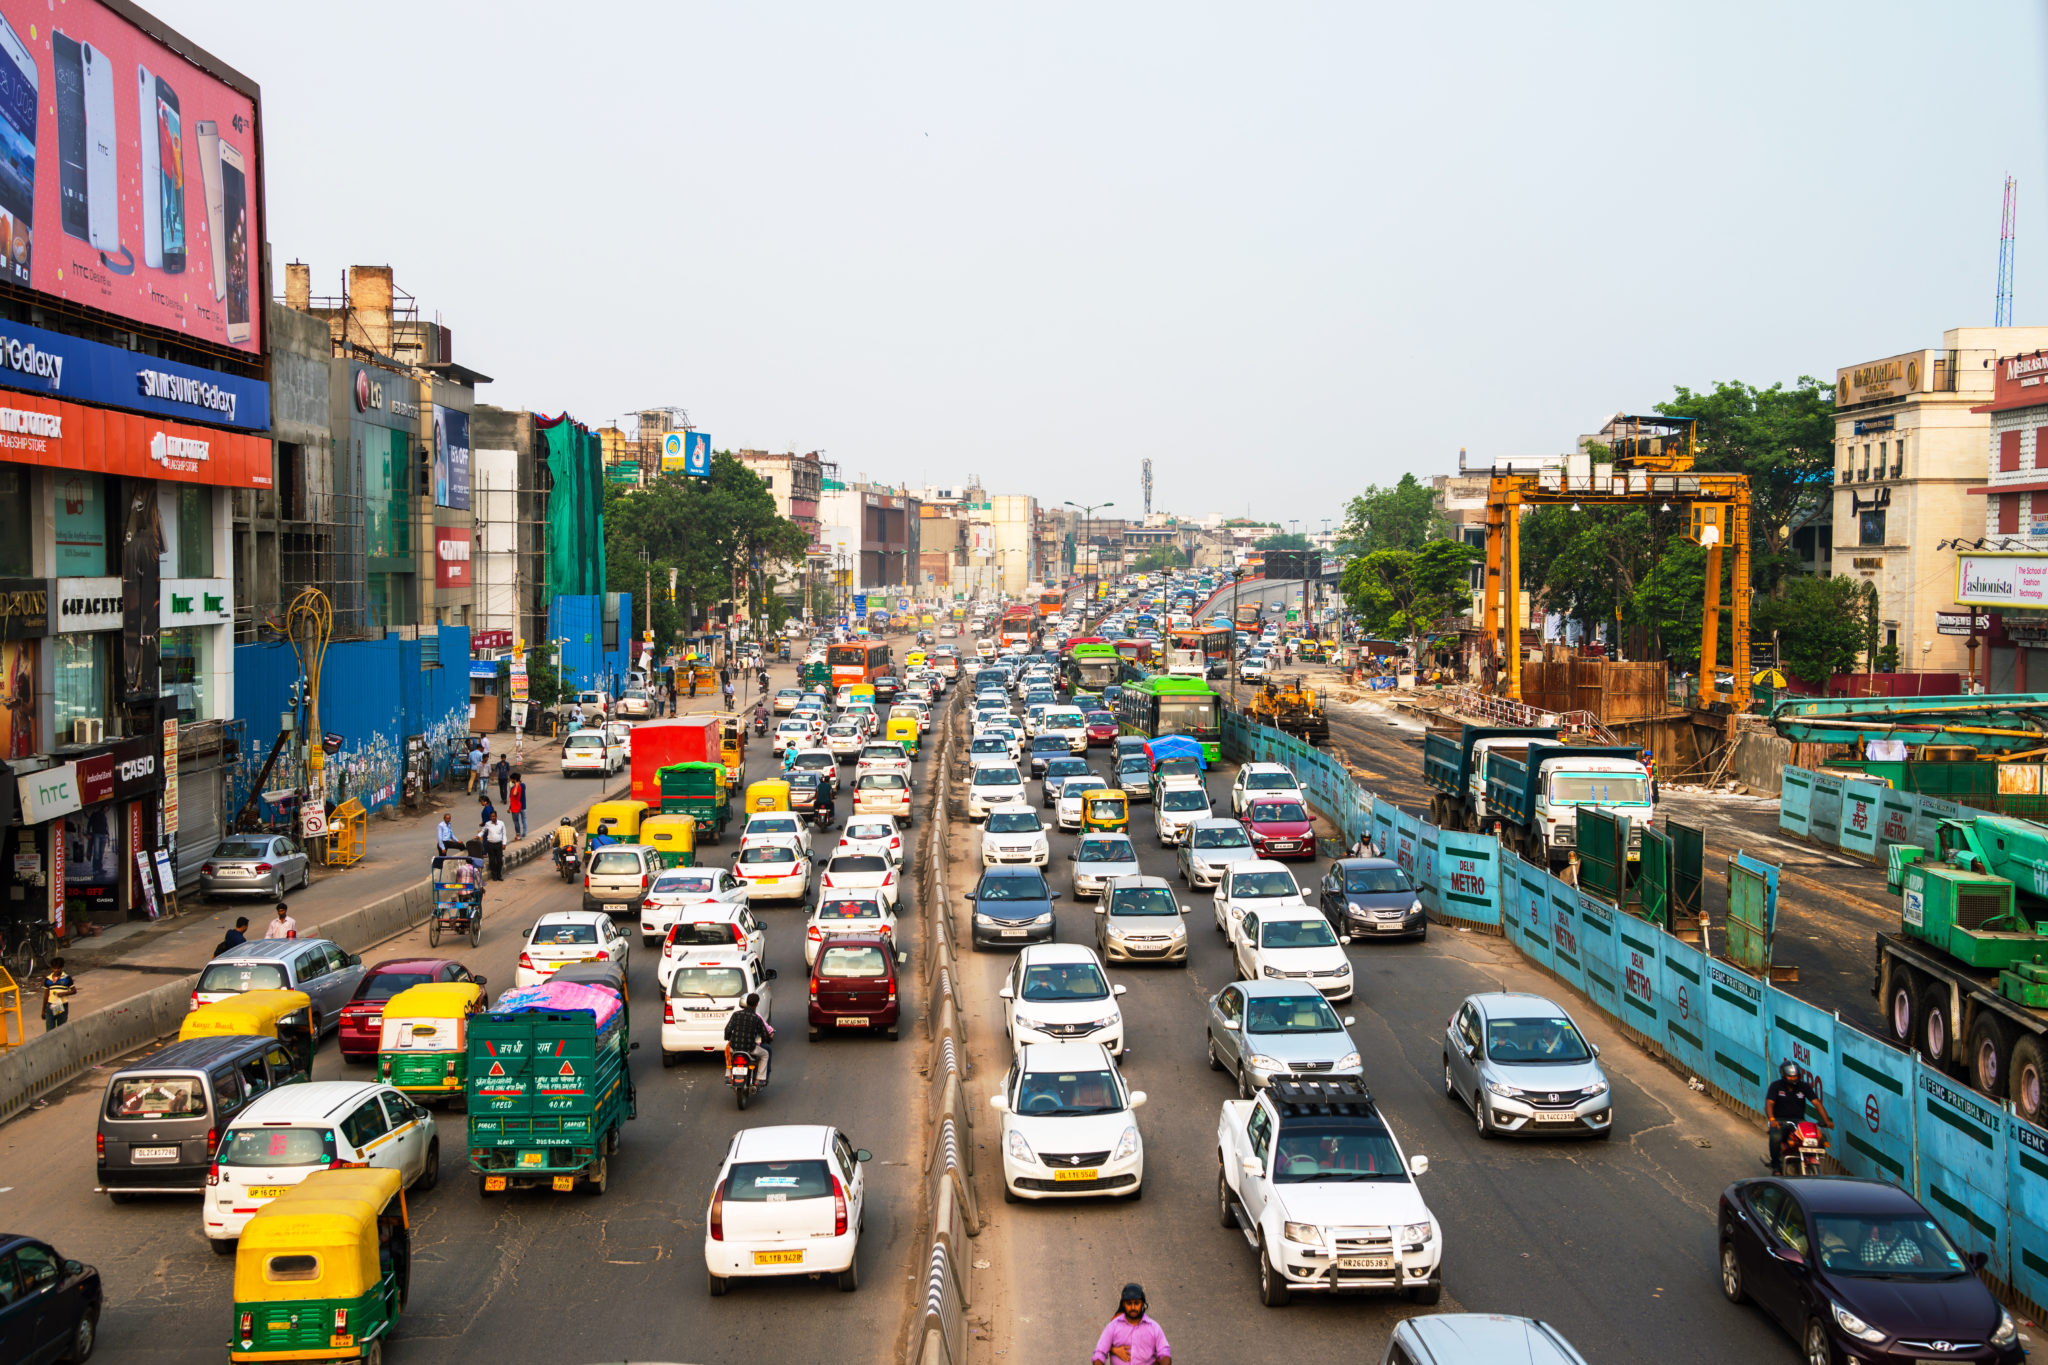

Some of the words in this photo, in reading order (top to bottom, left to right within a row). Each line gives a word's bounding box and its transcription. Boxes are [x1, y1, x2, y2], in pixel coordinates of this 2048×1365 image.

[232, 113, 243, 134] 4G
[72, 260, 89, 279] htc
[151, 289, 166, 306] htc
[197, 304, 211, 321] htc
[10, 338, 63, 390] Galaxy
[143, 369, 199, 405] SAMSUNG
[203, 382, 237, 422] Galaxy
[370, 380, 382, 409] LG
[1, 434, 28, 450] FLAGSHIP
[28, 438, 47, 453] STORE
[166, 436, 209, 461] micromax
[167, 459, 185, 472] FLAGSHIP
[185, 461, 199, 473] STORE
[1961, 560, 2013, 597] fashionista
[2018, 566, 2026, 575] The
[2026, 567, 2042, 575] School
[2041, 567, 2048, 575] of
[2023, 578, 2041, 586] Fashion
[172, 593, 194, 613] htc
[204, 592, 224, 612] htc
[2019, 588, 2043, 600] Technology
[121, 755, 155, 782] CASIO
[39, 782, 69, 806] htc
[1884, 821, 1907, 842] METRO
[1459, 860, 1475, 872] DELHI
[1451, 872, 1485, 895] METRO
[1557, 911, 1570, 929] DELHI
[1554, 924, 1577, 955] METRO
[1631, 952, 1644, 970] DELHI
[1625, 966, 1652, 1002] METRO
[1712, 967, 1726, 984] FEMC
[1726, 974, 1749, 995] PRATIBHA
[1748, 986, 1756, 998] JV
[499, 1043, 512, 1054] जय
[537, 1042, 552, 1054] राम
[1793, 1041, 1811, 1067] DELHI
[1927, 1077, 1946, 1100] FEMC
[1947, 1090, 1981, 1120] PRATIBHA
[1981, 1111, 1992, 1127] JV
[2020, 1129, 2046, 1152] FEMC
